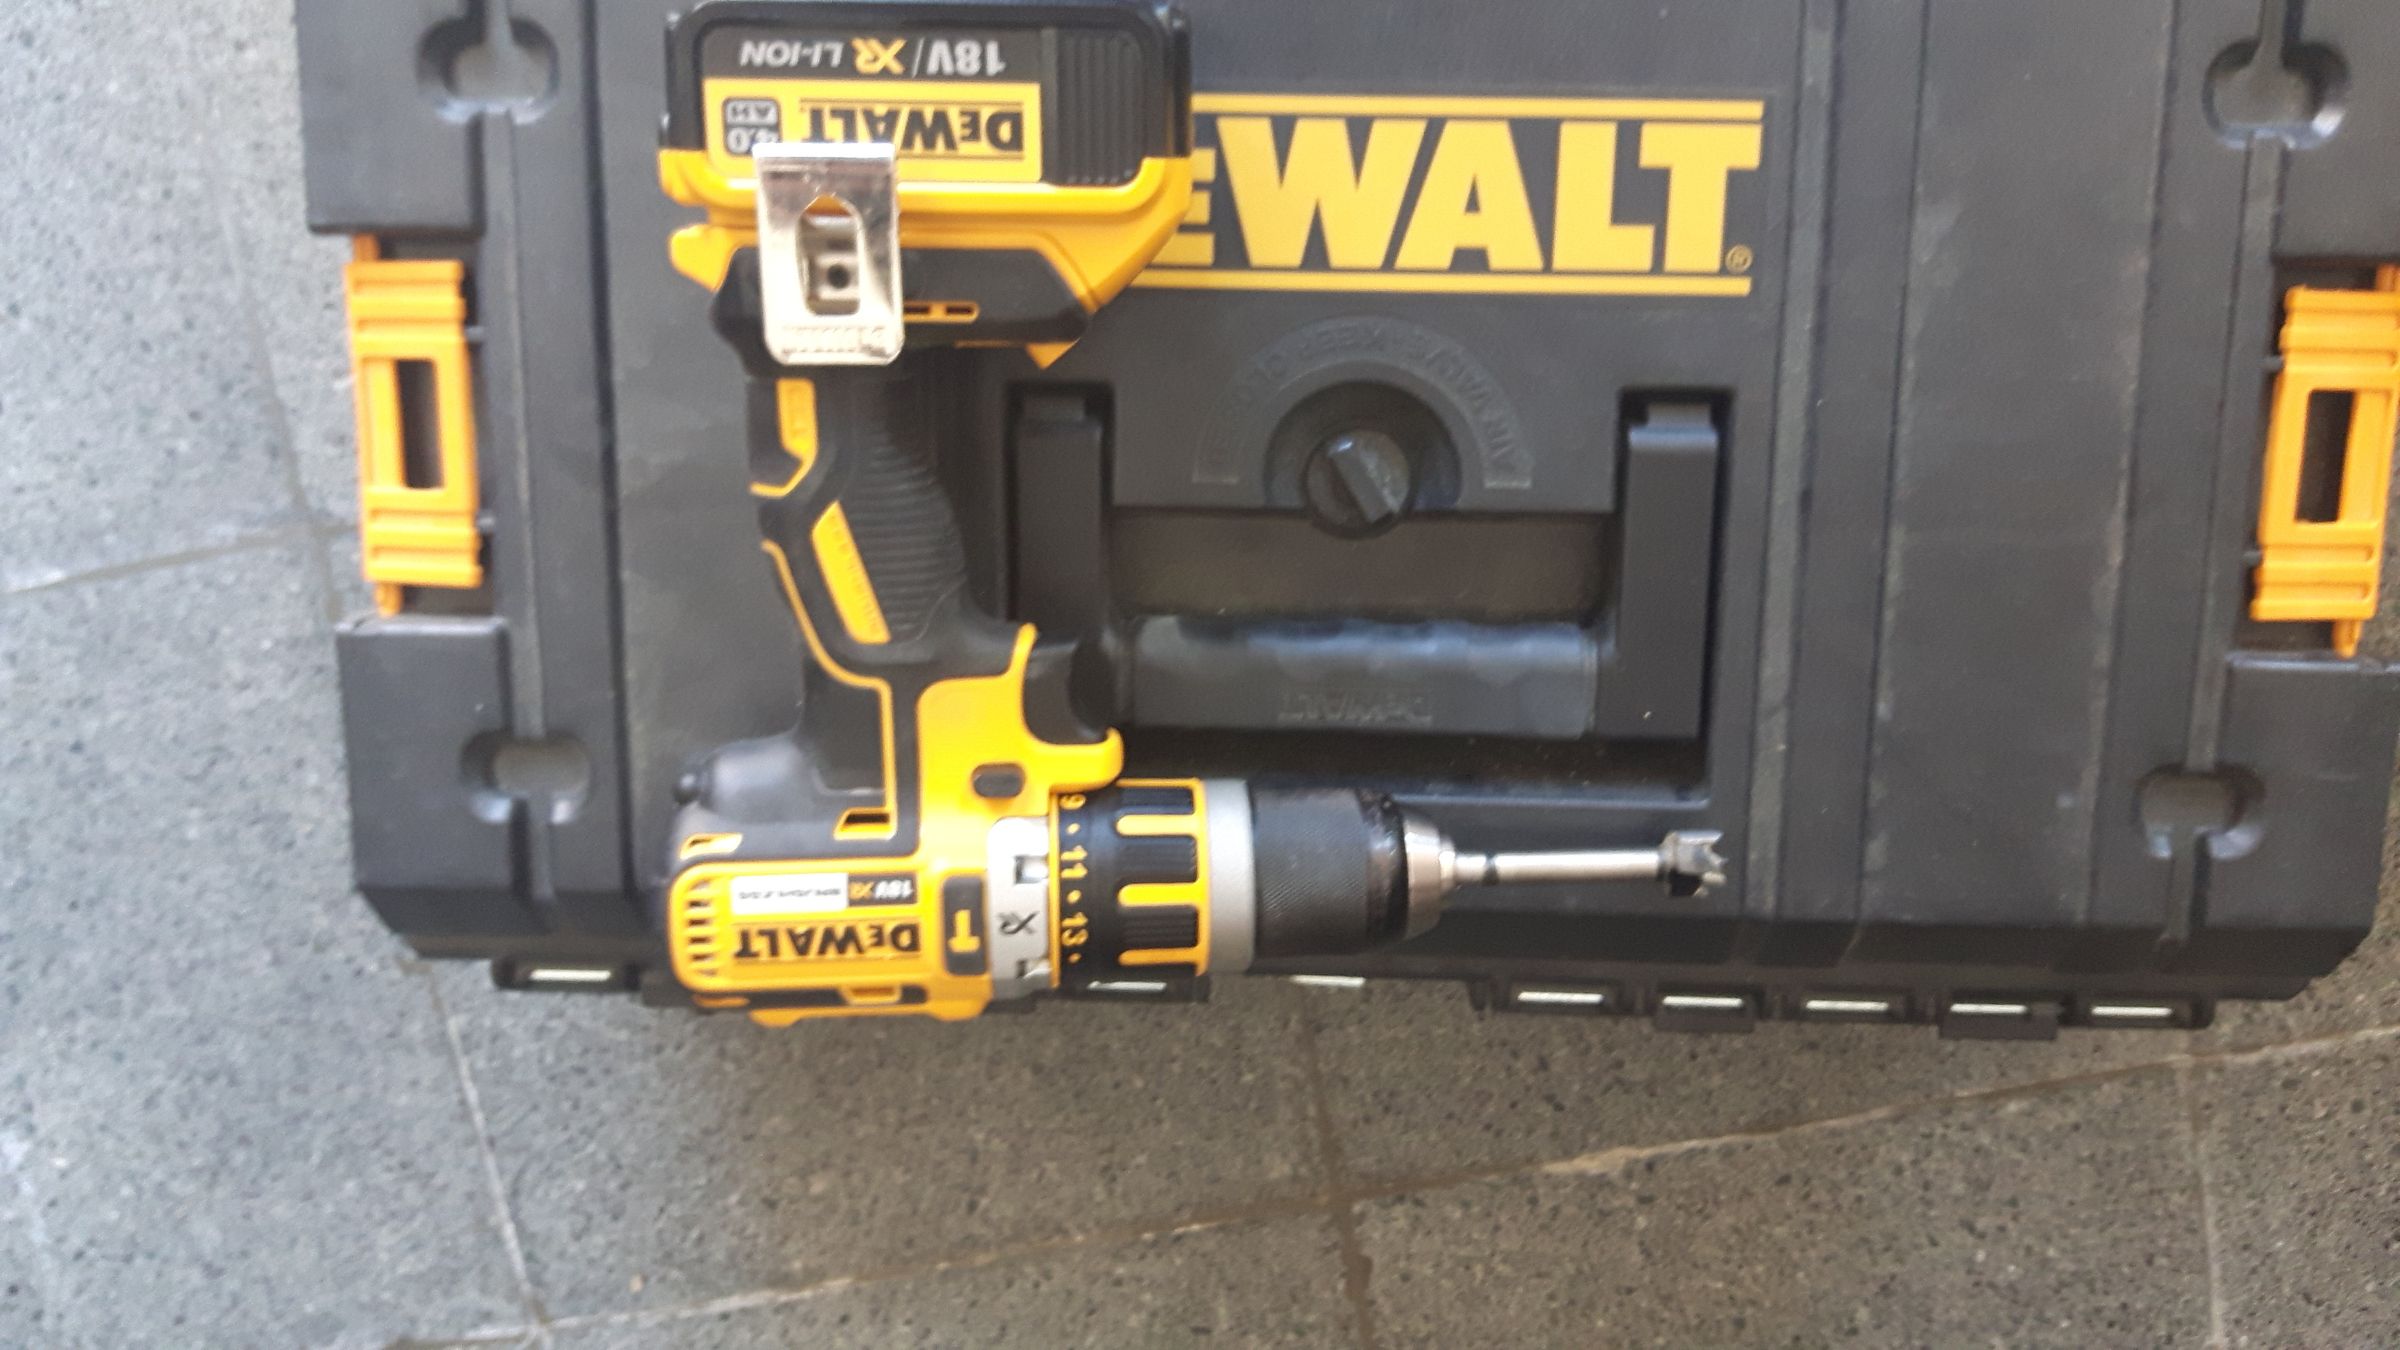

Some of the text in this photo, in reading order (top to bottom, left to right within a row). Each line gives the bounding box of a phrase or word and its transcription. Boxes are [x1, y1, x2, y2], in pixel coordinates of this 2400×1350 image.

[740, 40, 843, 68] LI-ION
[805, 108, 1024, 154] DEWALT
[1060, 844, 1088, 879] 11
[734, 922, 921, 960] DEWALT
[1061, 911, 1089, 947] 13
